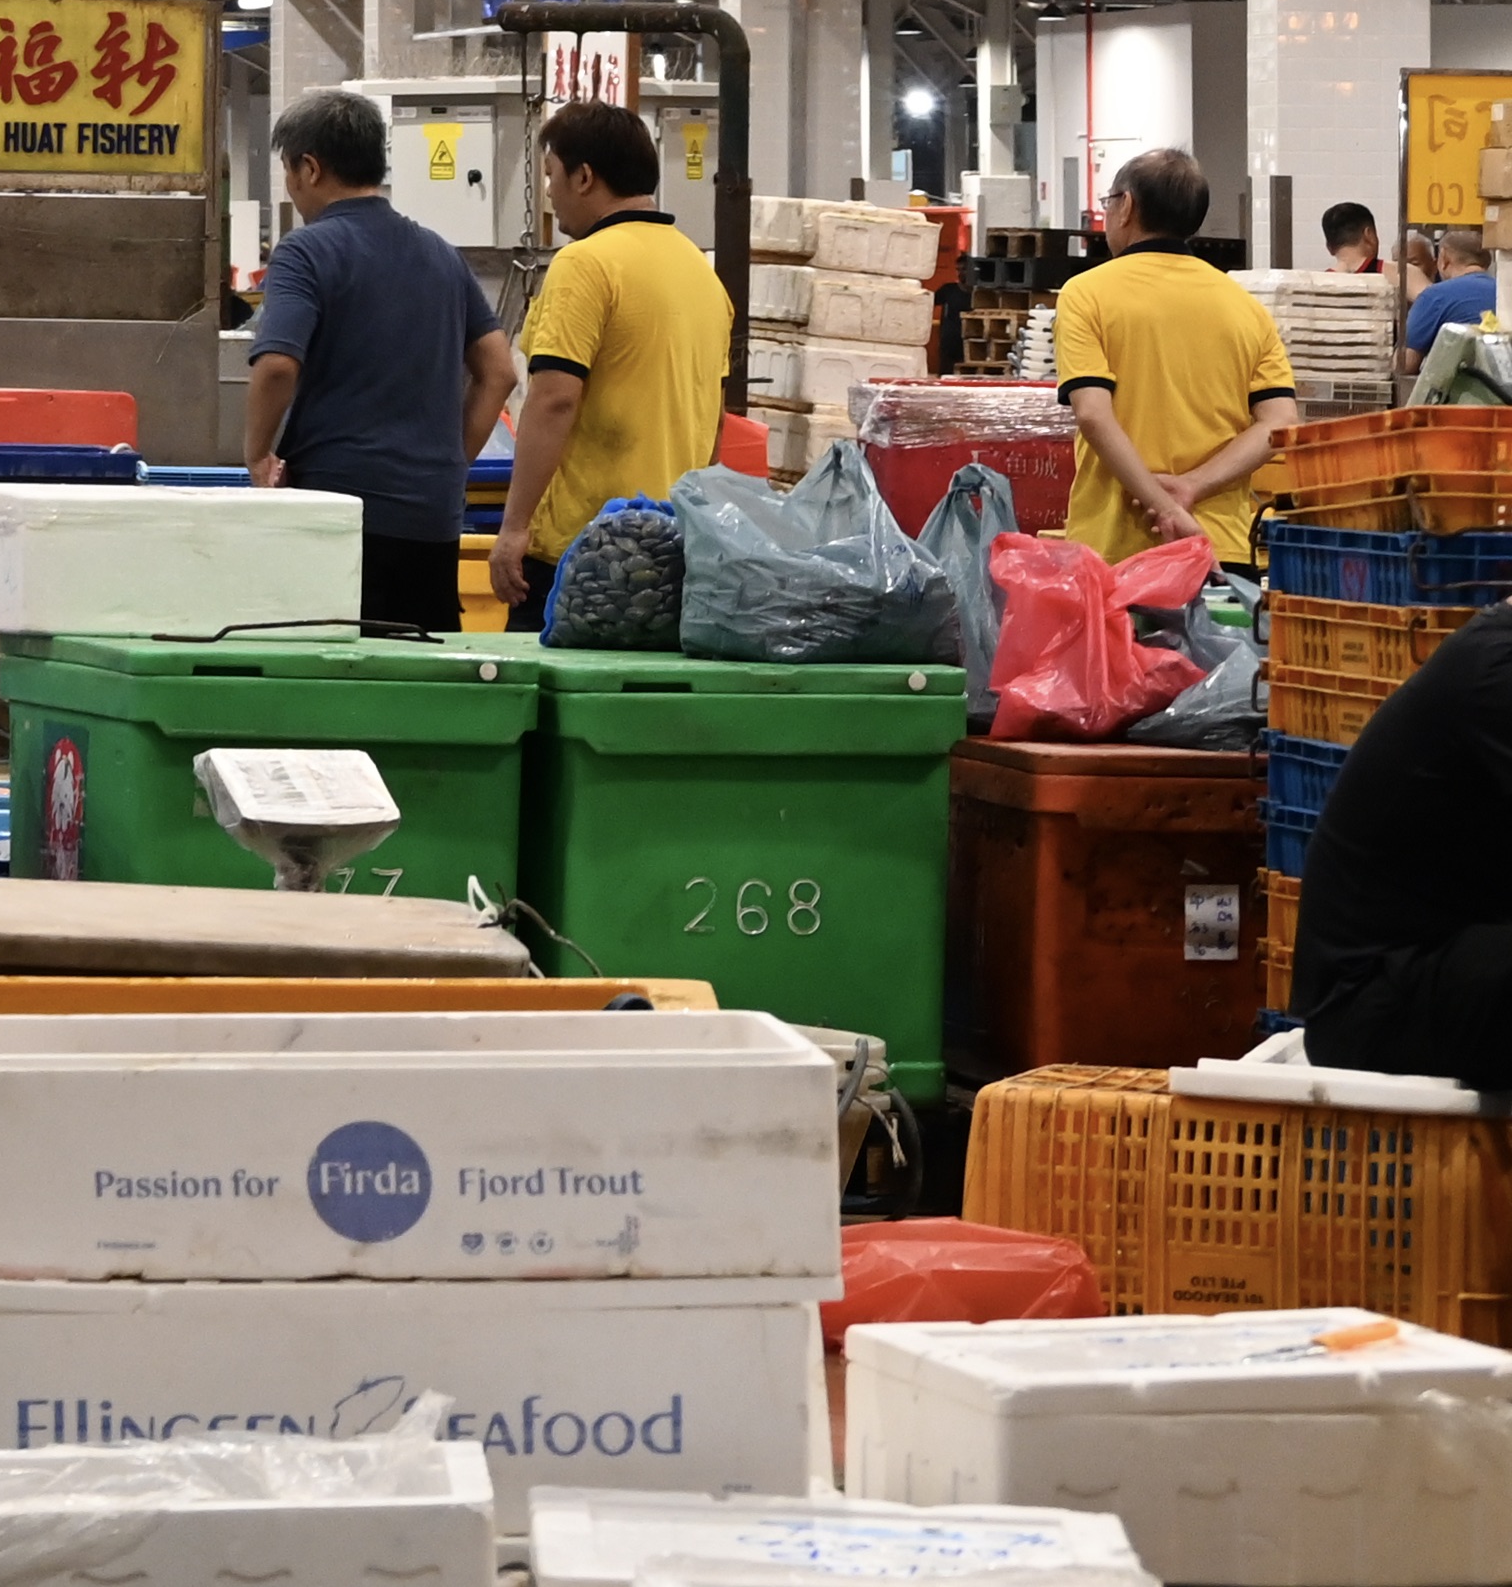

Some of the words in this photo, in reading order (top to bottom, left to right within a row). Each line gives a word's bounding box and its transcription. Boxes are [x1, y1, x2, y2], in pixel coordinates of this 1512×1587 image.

[4, 121, 67, 154] HUAT
[77, 123, 180, 156] FISHERY
[683, 876, 821, 936] 268
[94, 1168, 222, 1199] Passion
[233, 1168, 280, 1198] for
[318, 1162, 422, 1197] Firda
[457, 1167, 545, 1202] Fjord
[550, 1167, 645, 1197] Trout
